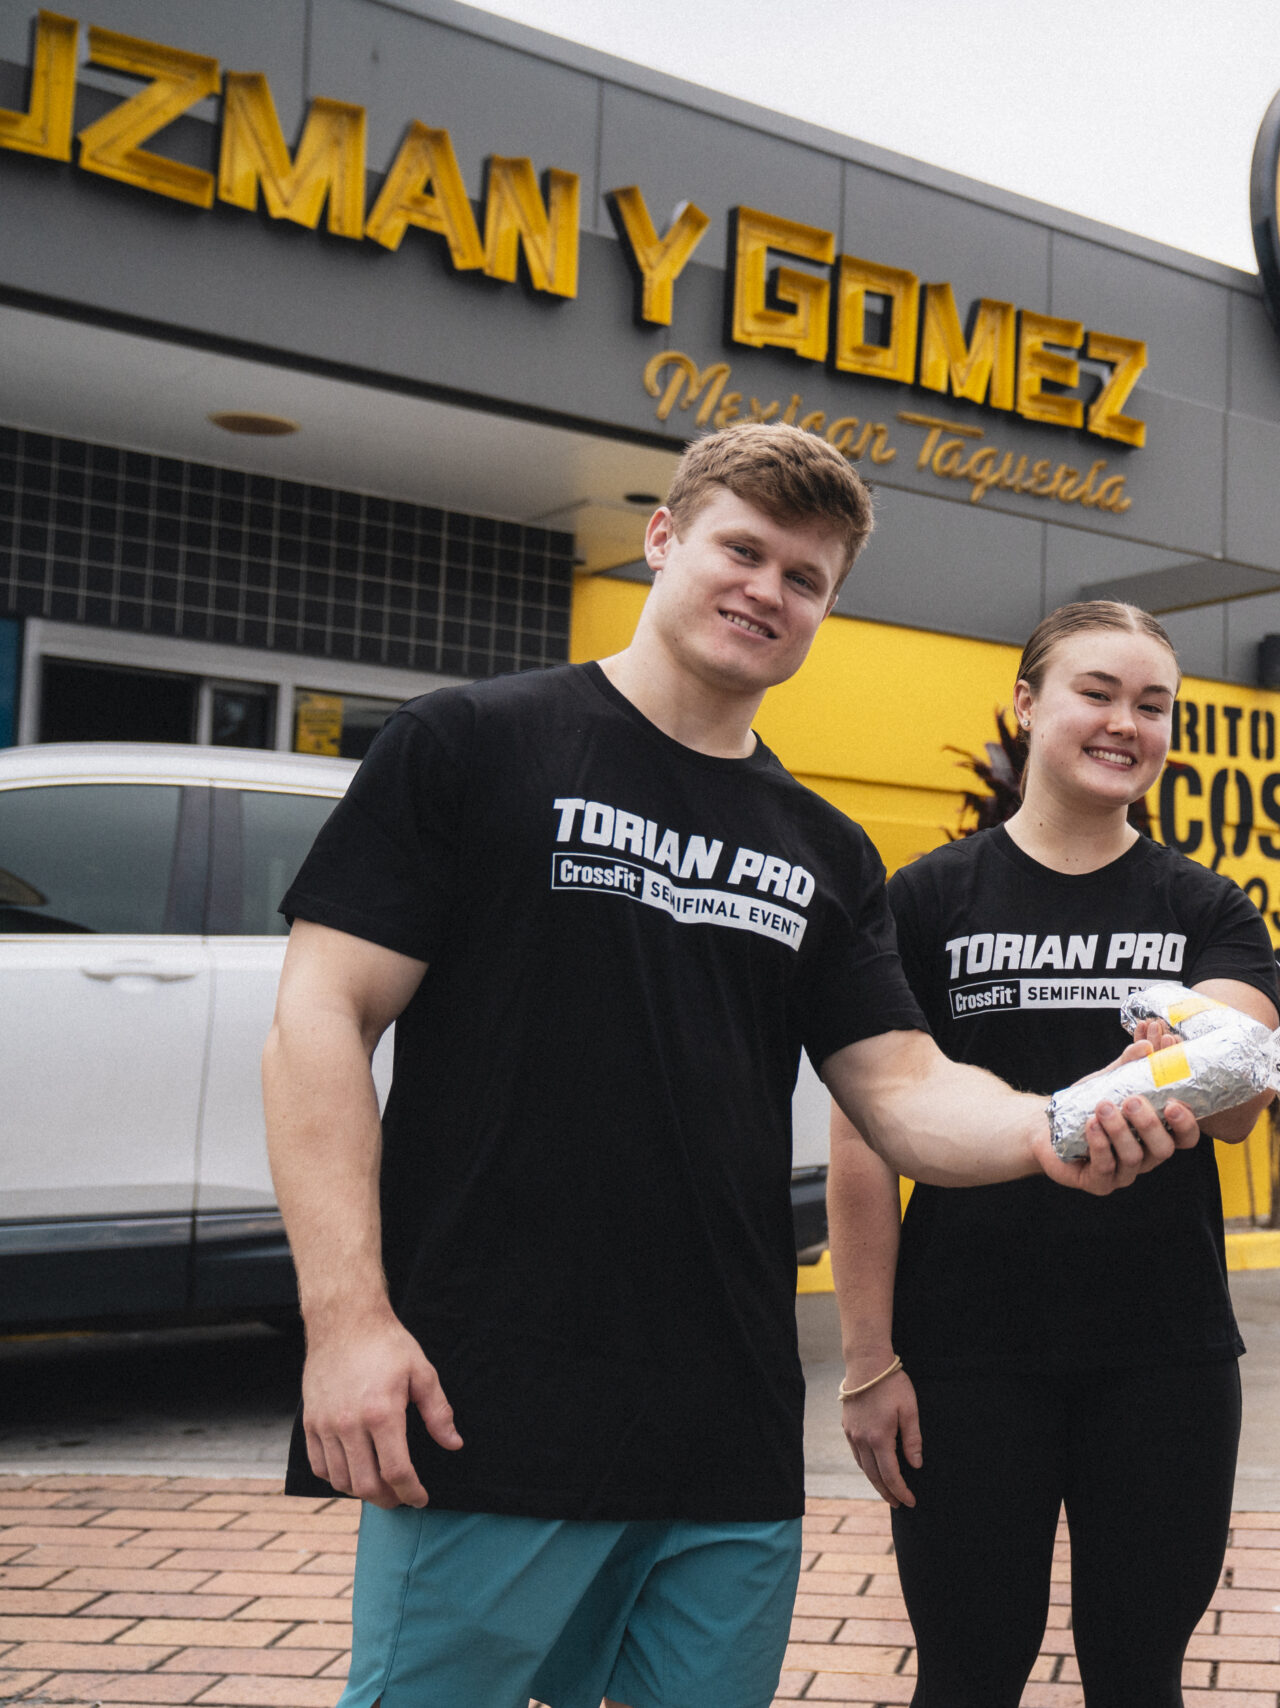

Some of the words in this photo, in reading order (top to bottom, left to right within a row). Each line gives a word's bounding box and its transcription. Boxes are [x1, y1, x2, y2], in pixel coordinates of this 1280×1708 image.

[607, 185, 711, 327] Y
[730, 205, 1148, 449] GOMEZ
[553, 798, 724, 880] TORIAN
[727, 847, 816, 908] PRO
[560, 859, 637, 892] CrossFit
[651, 881, 740, 919] SEMIFINAL
[749, 906, 800, 939] EVENT
[945, 933, 1099, 980] TORIAN
[1105, 932, 1187, 972] PRO
[955, 986, 1014, 1012] CrossFit
[1027, 985, 1120, 1000] SEMIFINAL
